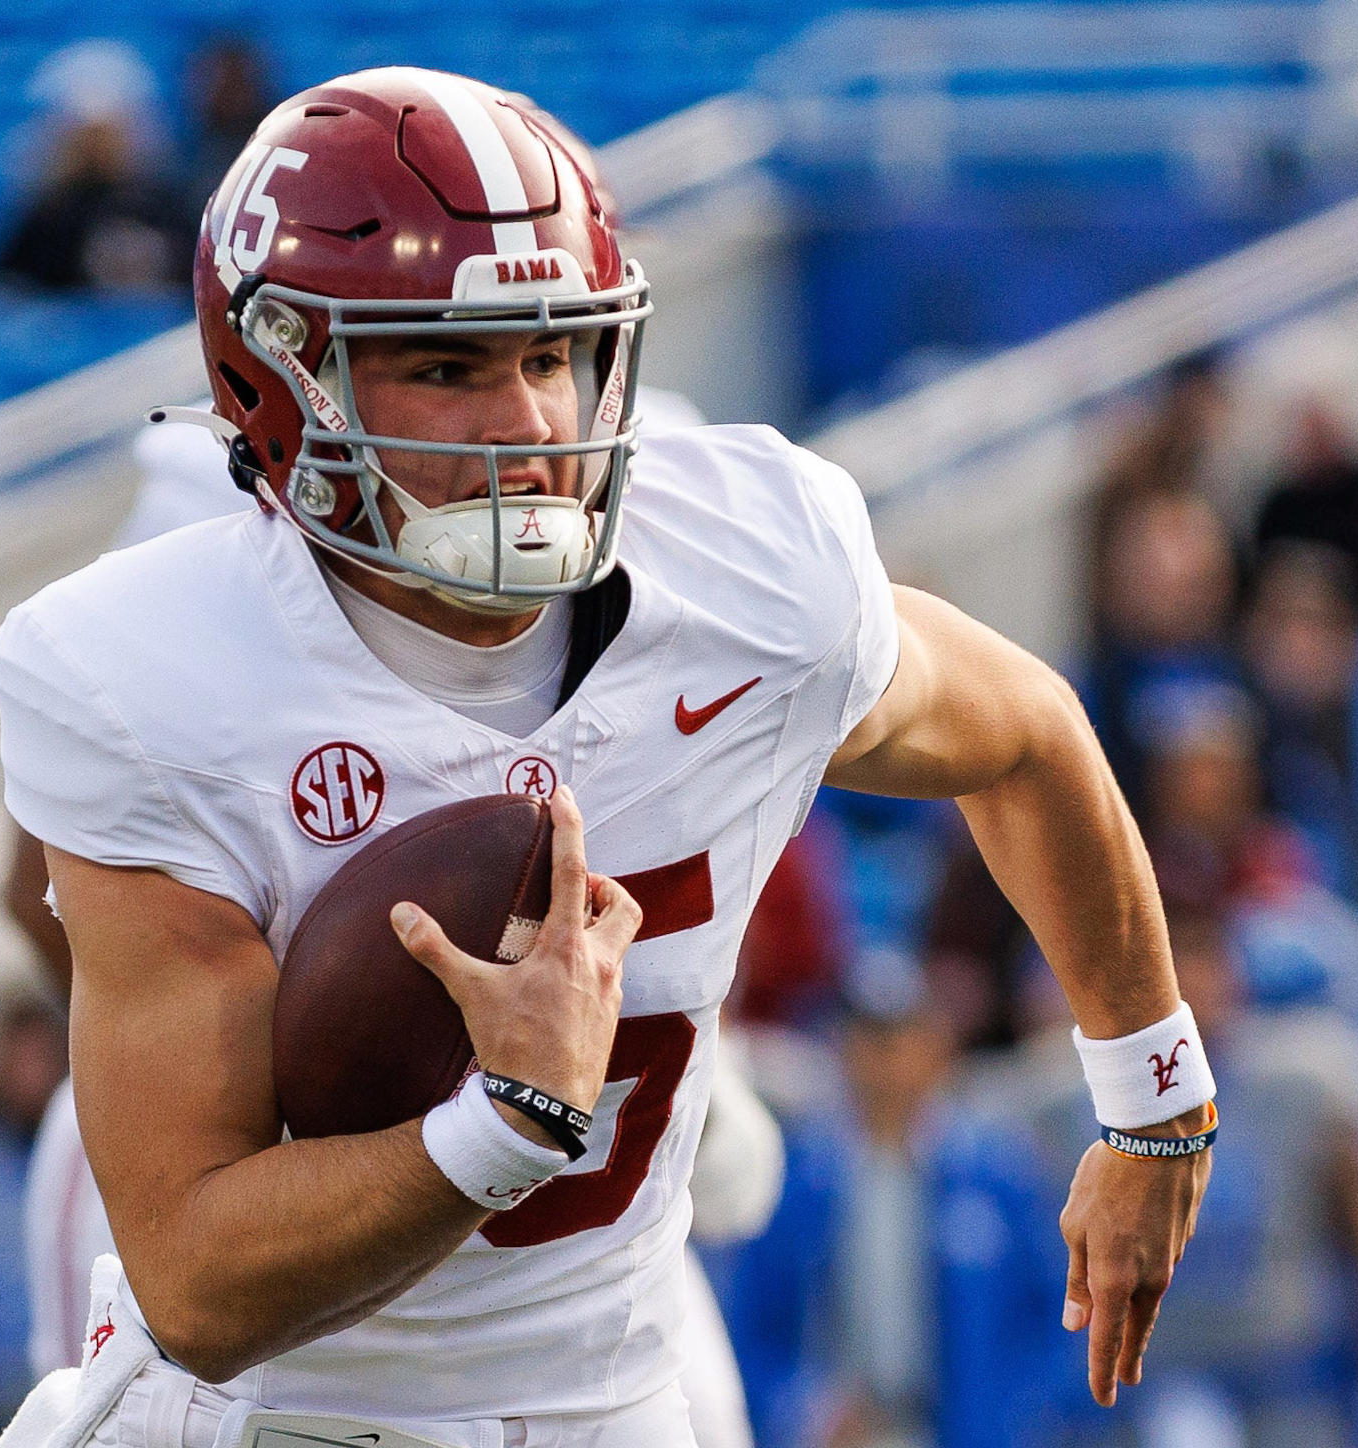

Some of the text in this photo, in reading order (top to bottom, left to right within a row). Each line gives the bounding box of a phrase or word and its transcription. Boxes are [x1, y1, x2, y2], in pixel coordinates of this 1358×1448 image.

[214, 143, 310, 296] 15
[495, 257, 563, 284] BAMA
[328, 410, 349, 433] TI
[514, 508, 545, 538] A
[296, 747, 380, 837] SEC
[523, 762, 547, 797] A
[533, 1094, 563, 1118] QB
[1107, 1131, 1208, 1158] SKYHAWKS
